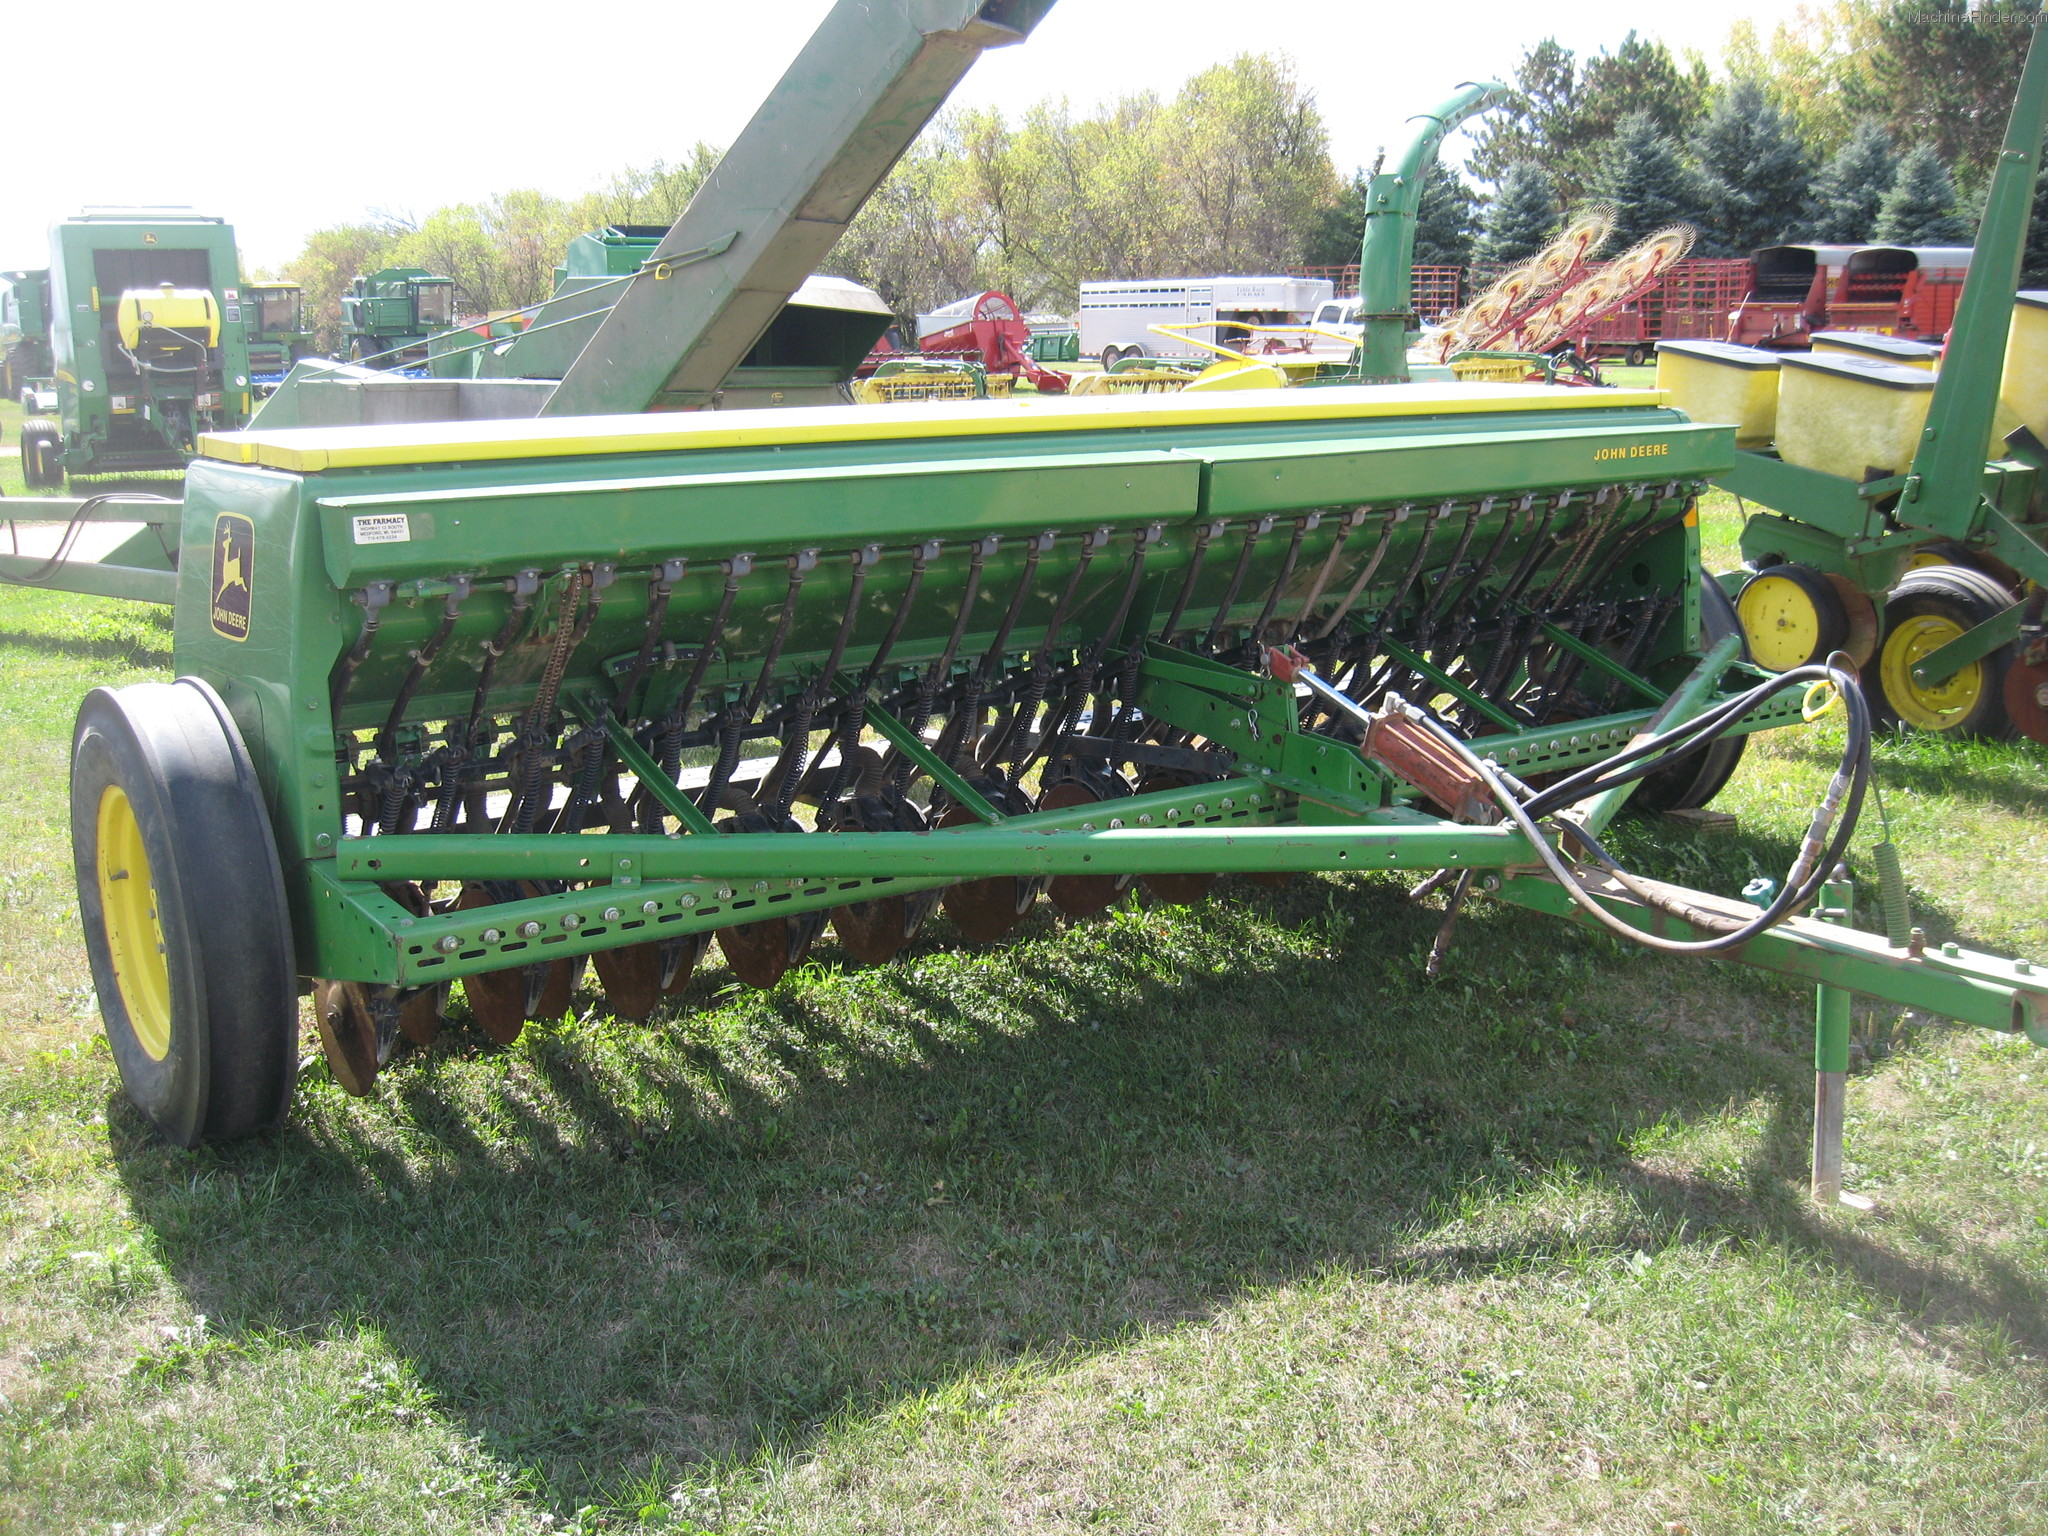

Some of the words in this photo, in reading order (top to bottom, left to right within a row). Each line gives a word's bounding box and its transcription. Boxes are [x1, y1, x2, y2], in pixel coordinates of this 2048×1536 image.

[1593, 447, 1626, 461] JOHN
[1630, 443, 1668, 458] DEERE
[213, 607, 228, 625] JOHN
[228, 611, 247, 631] DEERE
